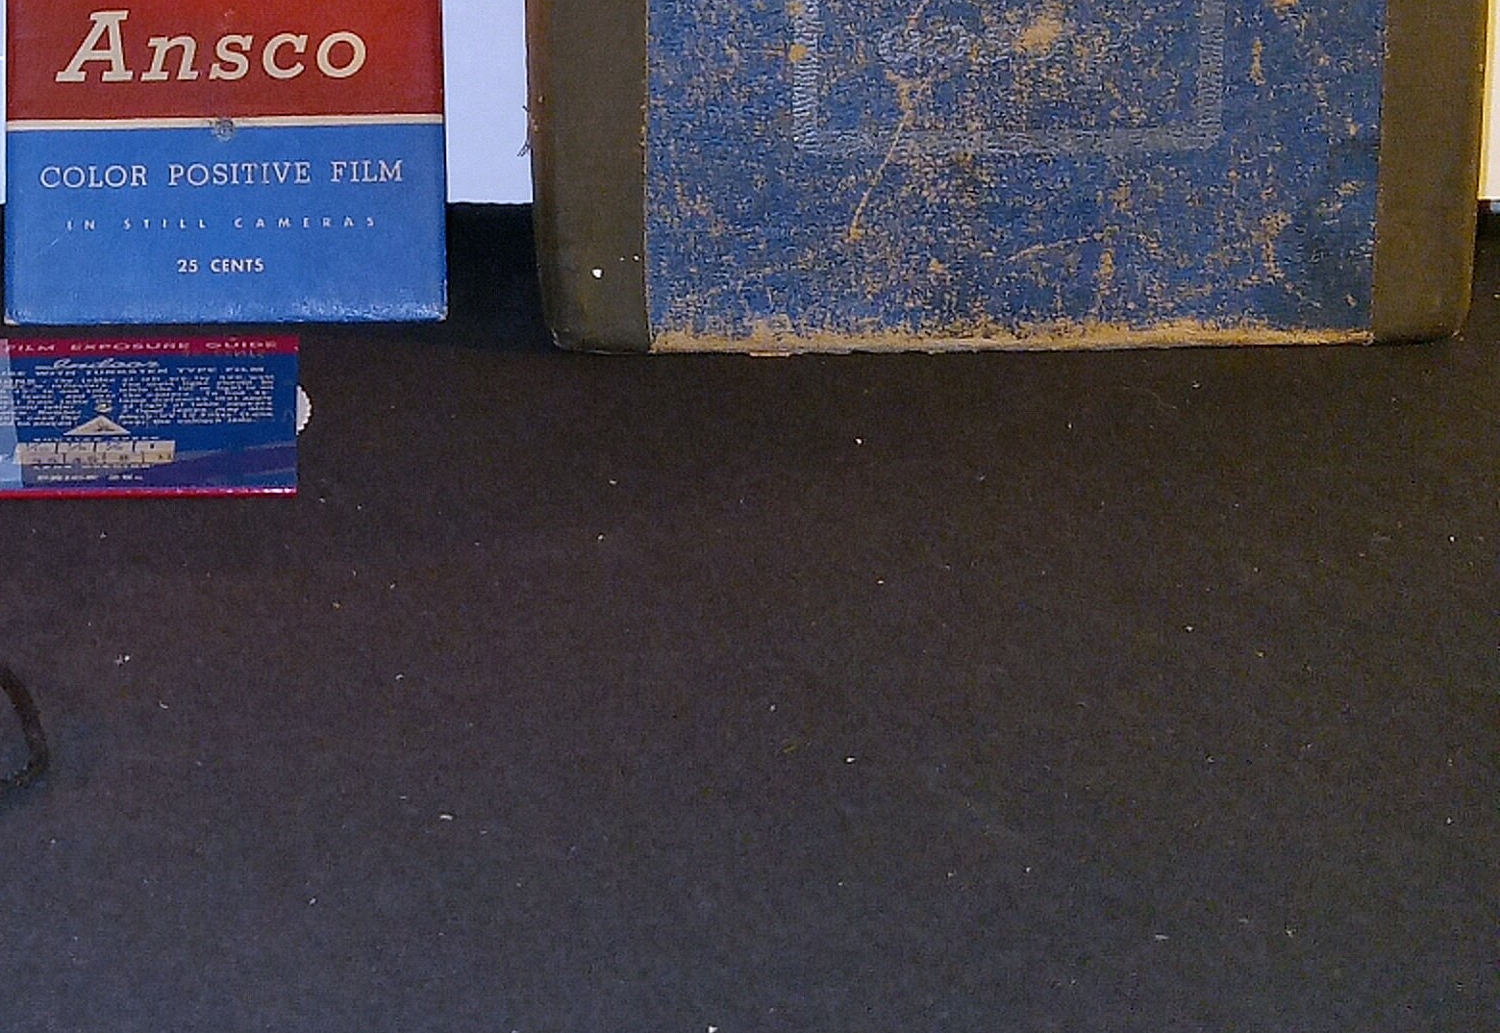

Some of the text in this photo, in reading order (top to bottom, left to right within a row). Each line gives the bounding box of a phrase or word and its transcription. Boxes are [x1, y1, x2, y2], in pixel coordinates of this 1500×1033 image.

[55, 10, 367, 83] Ansco
[40, 159, 403, 189] COLOR POSITIVE FILM
[66, 216, 375, 232] IN STILL CAMERAS
[177, 258, 265, 274] 25 CENTS
